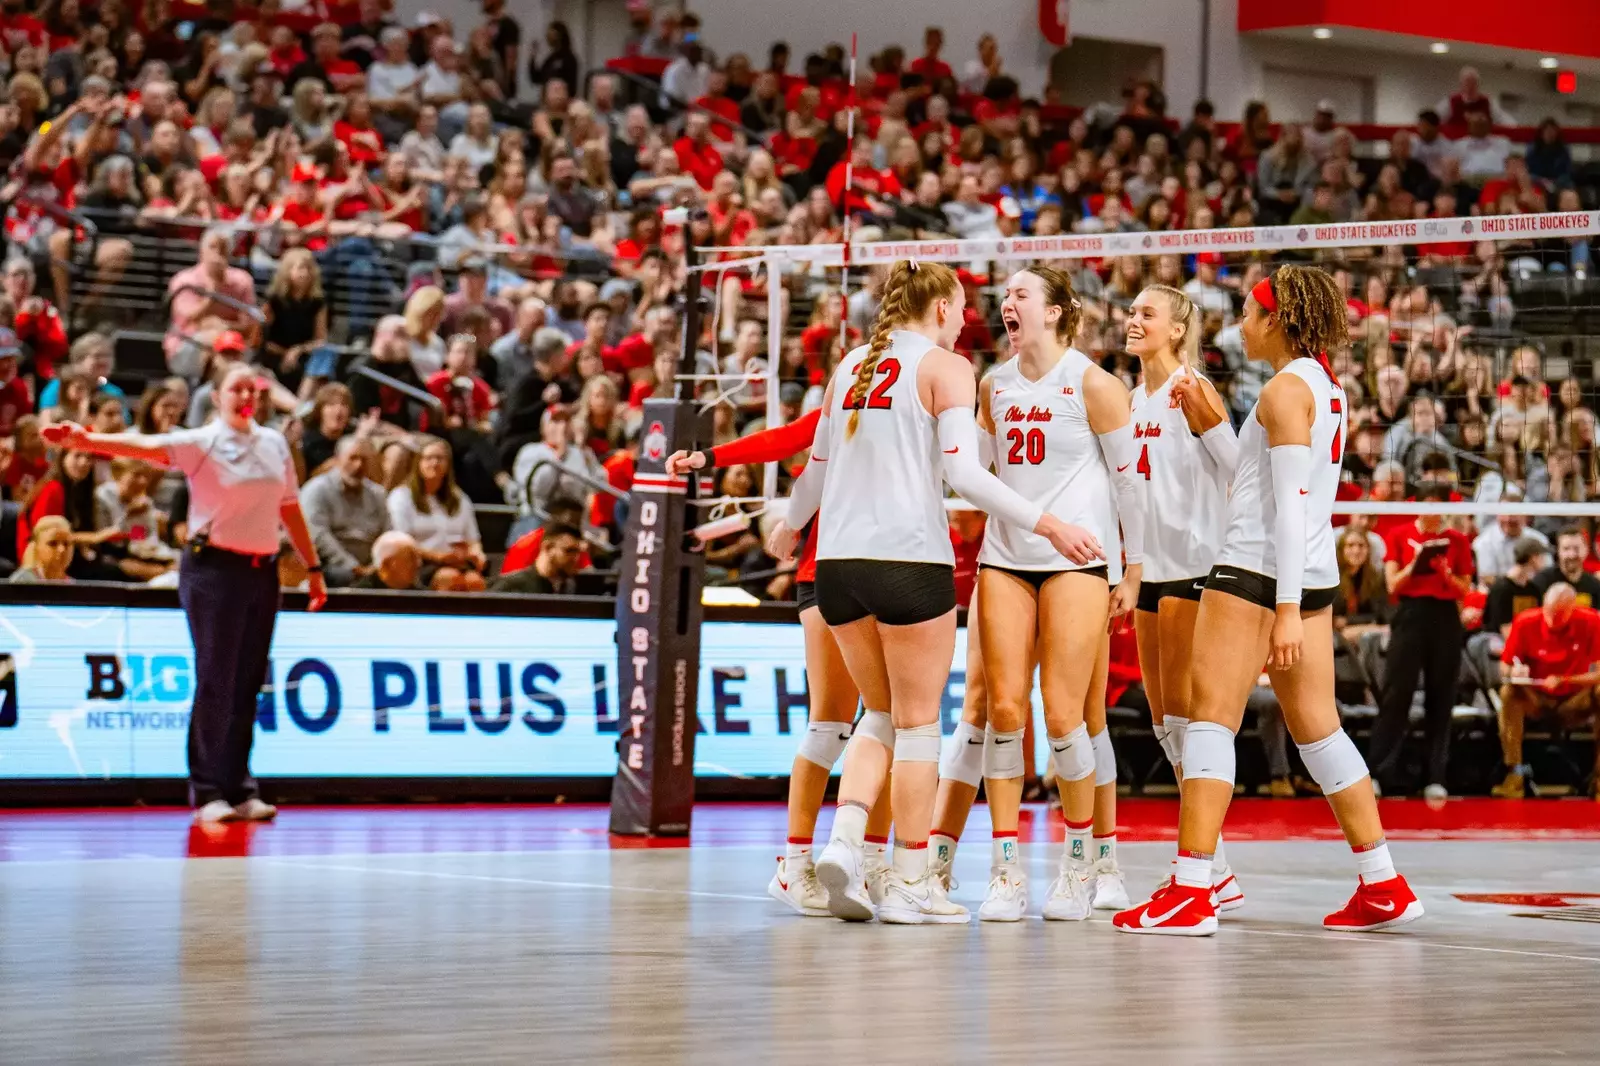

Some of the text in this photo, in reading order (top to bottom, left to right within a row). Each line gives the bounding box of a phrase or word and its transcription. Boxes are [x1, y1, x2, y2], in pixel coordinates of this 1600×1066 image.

[1183, 233, 1209, 246] STATE
[1211, 231, 1255, 245] BUCKEYES
[1315, 228, 1338, 240] OHIO
[1340, 226, 1367, 239] STATE
[1370, 223, 1417, 238] BUCKEYES
[1481, 214, 1589, 232] OHIO STATE BUCKEYES
[842, 358, 902, 410] 22
[1004, 405, 1053, 422] Ohio State
[1006, 428, 1046, 465] 20
[1137, 443, 1151, 480] 4
[628, 501, 658, 770] OHIO STATE
[371, 660, 567, 737] PLUS
